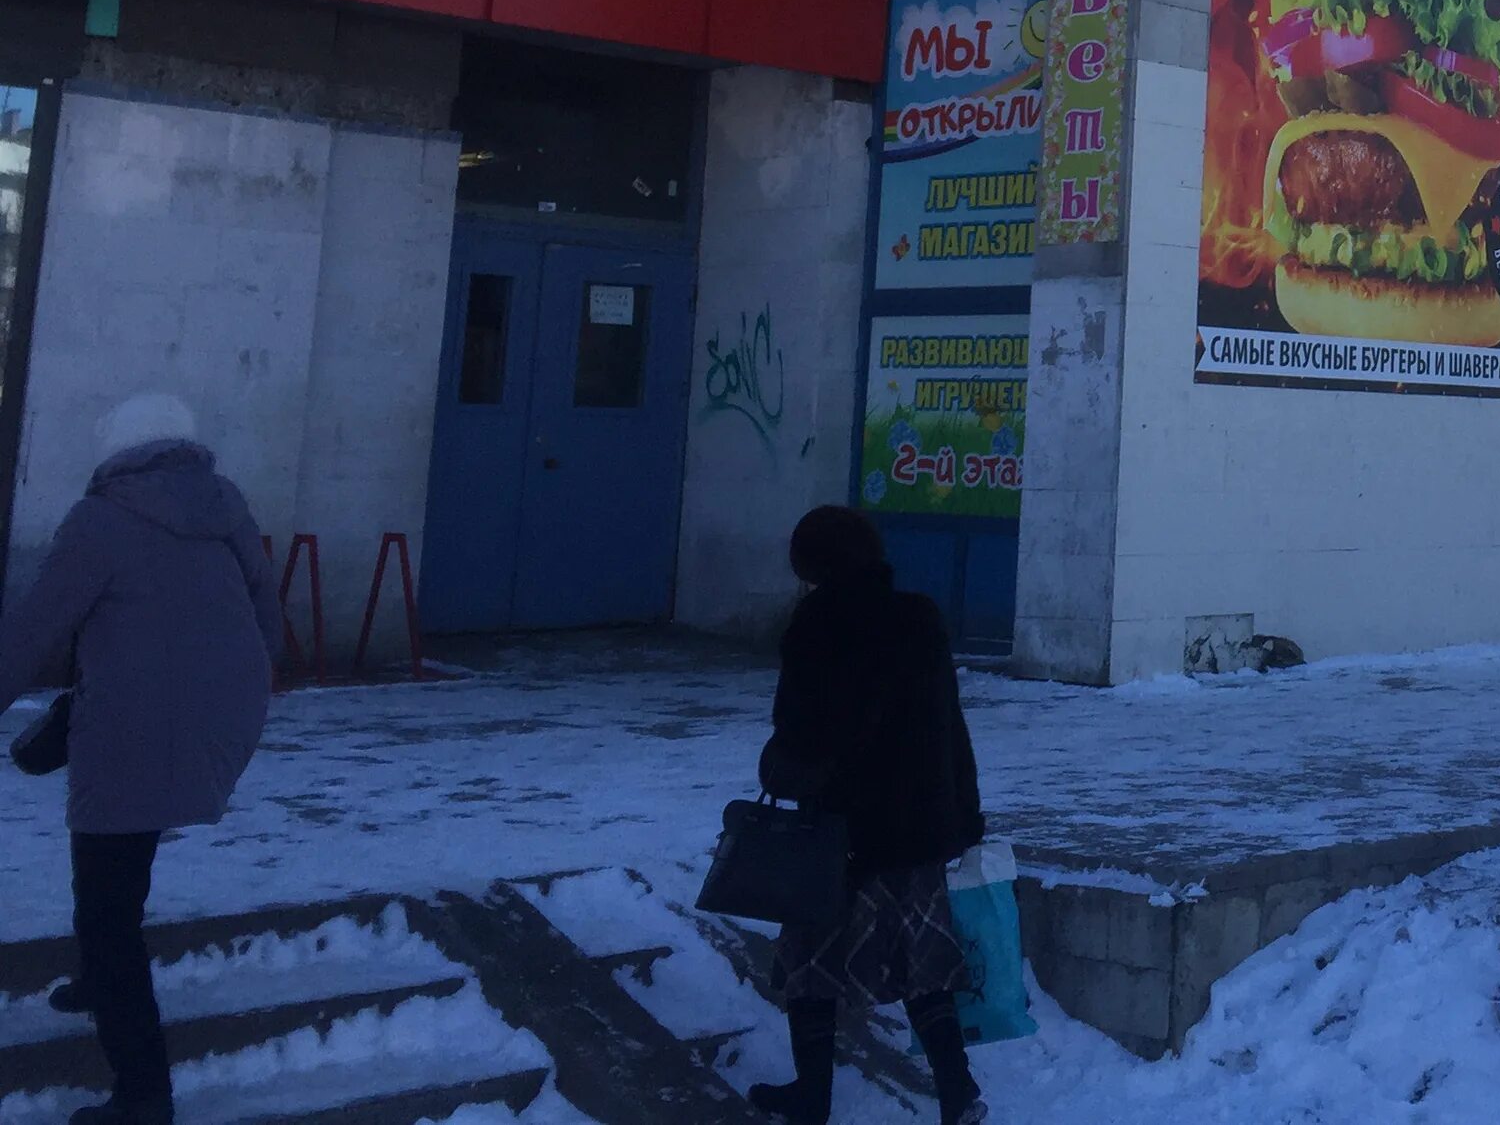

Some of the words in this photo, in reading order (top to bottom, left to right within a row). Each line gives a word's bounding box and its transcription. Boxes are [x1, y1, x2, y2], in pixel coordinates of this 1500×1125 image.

[903, 20, 993, 77] МЫ
[1210, 335, 1275, 366] САМЫЕ
[1279, 340, 1358, 372] ВКУСНЫЕ
[1361, 346, 1431, 377] БУРГЕРЫ
[1434, 354, 1446, 377] И
